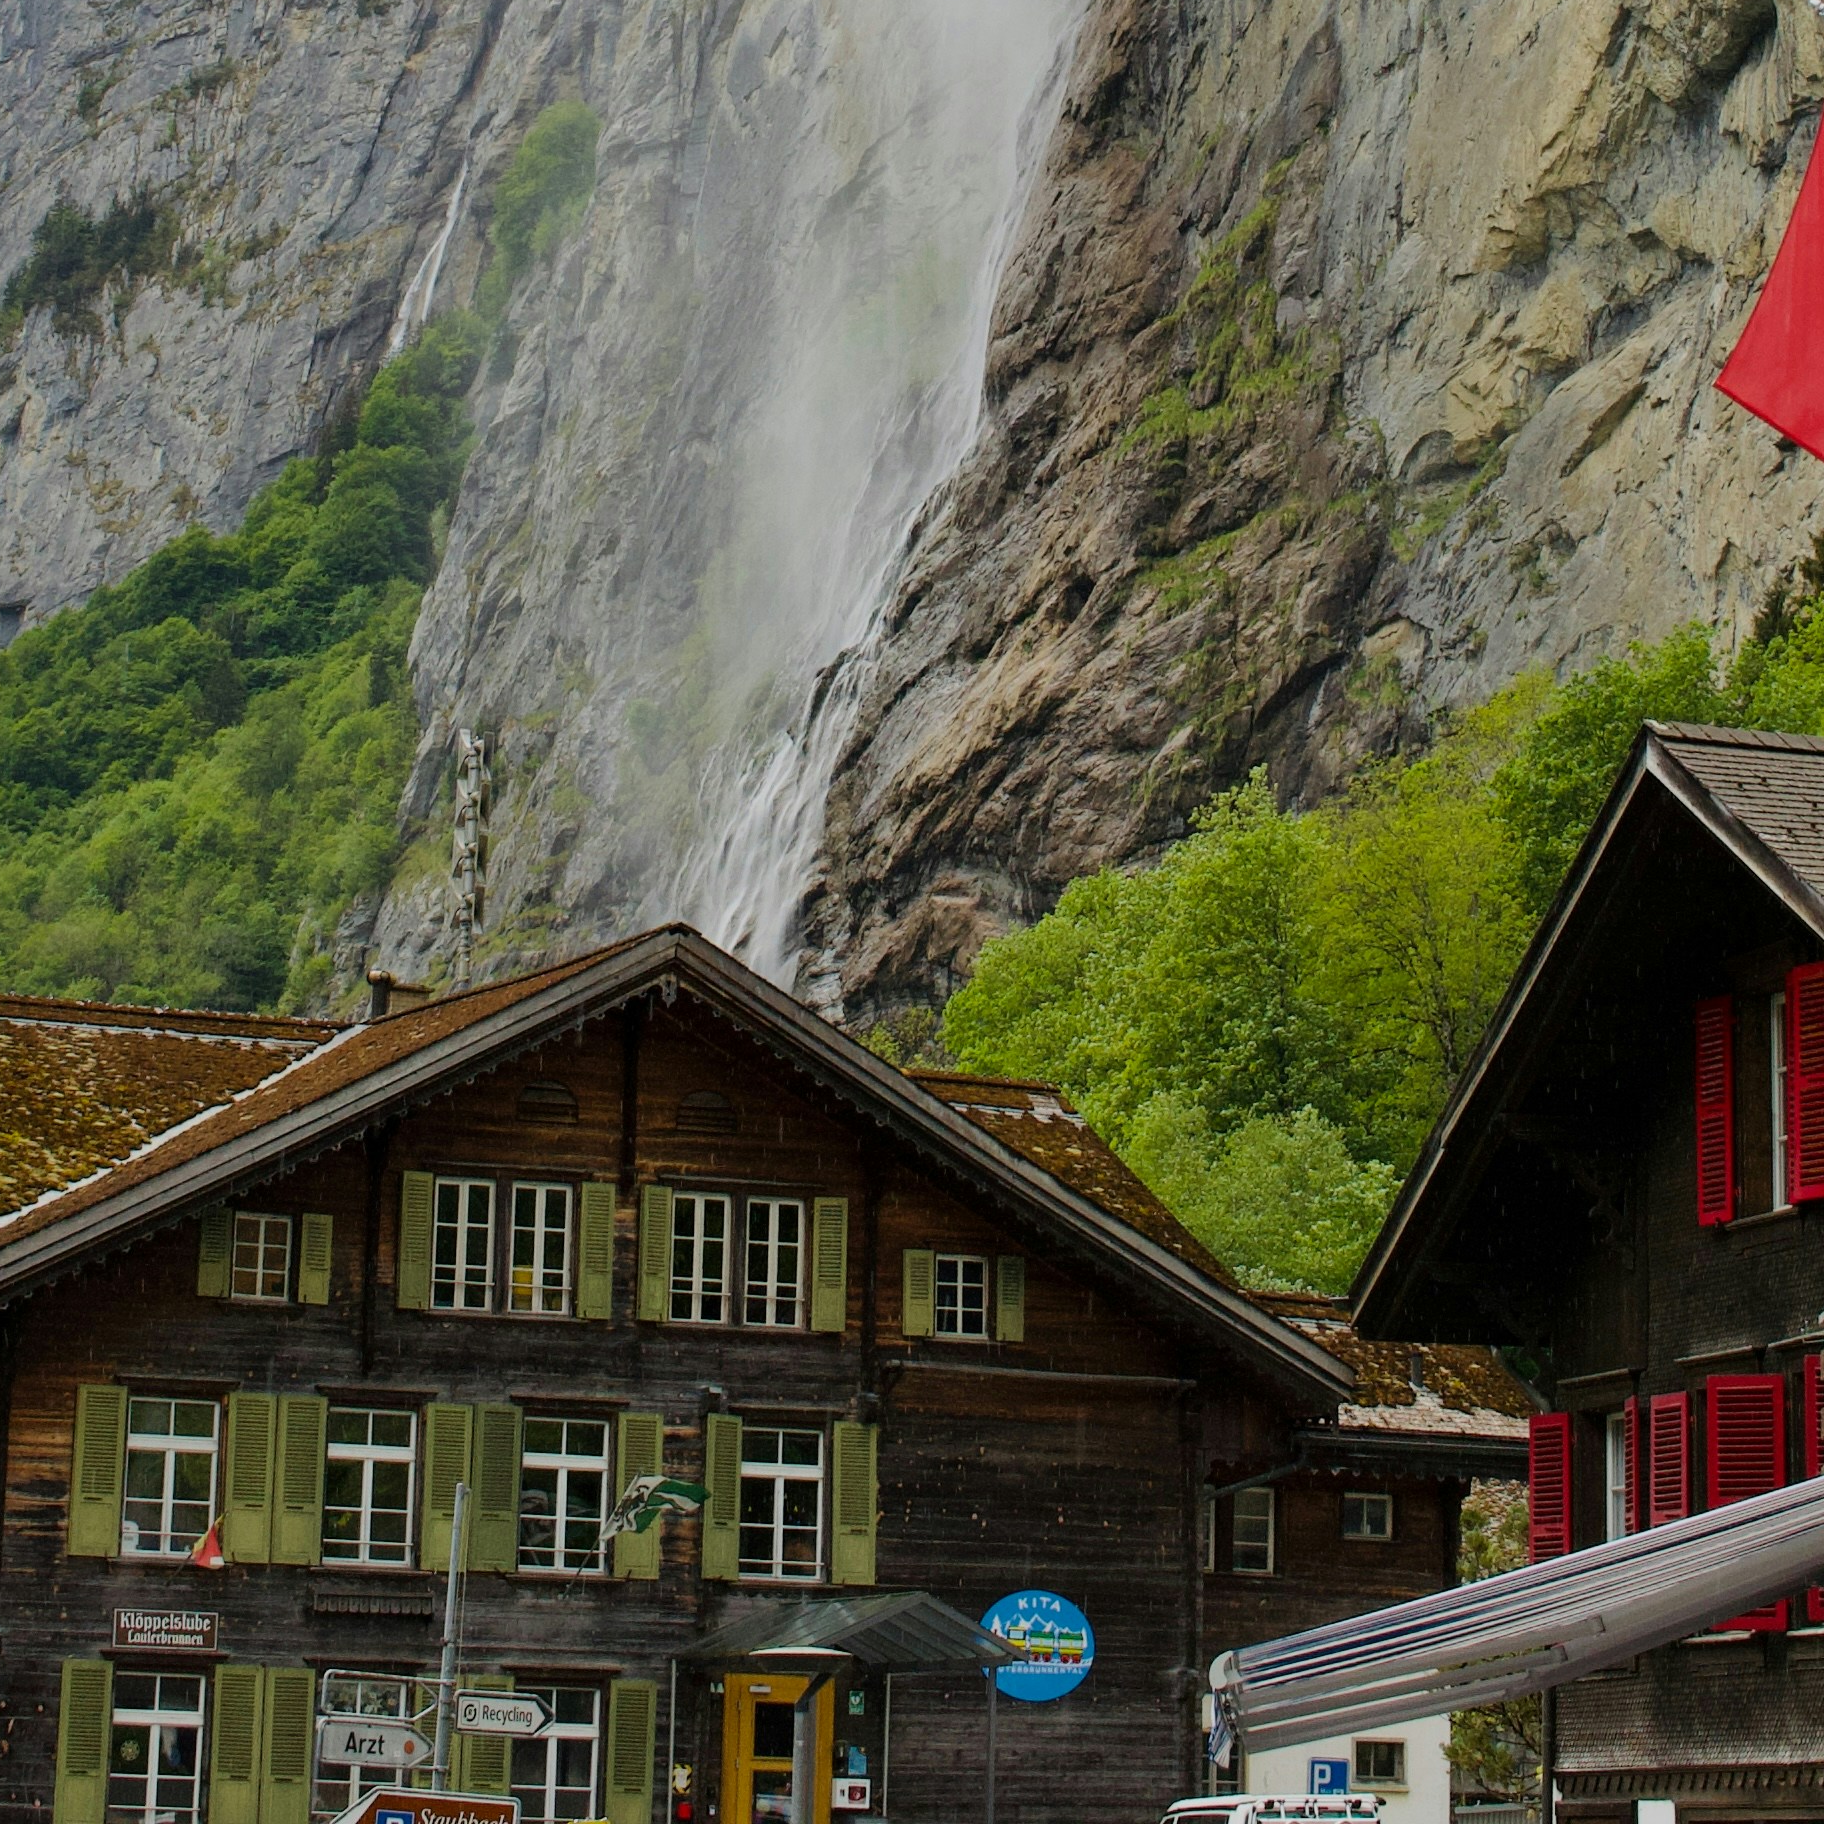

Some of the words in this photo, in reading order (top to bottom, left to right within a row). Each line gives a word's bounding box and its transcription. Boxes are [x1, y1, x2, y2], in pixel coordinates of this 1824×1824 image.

[1018, 1596, 1061, 1612] KITA
[120, 1612, 211, 1632] Klöppelstube
[127, 1629, 204, 1646] Lauterbrunnen
[482, 1705, 533, 1726] Recycling
[344, 1731, 385, 1756] Arzt
[1314, 1763, 1332, 1794] P
